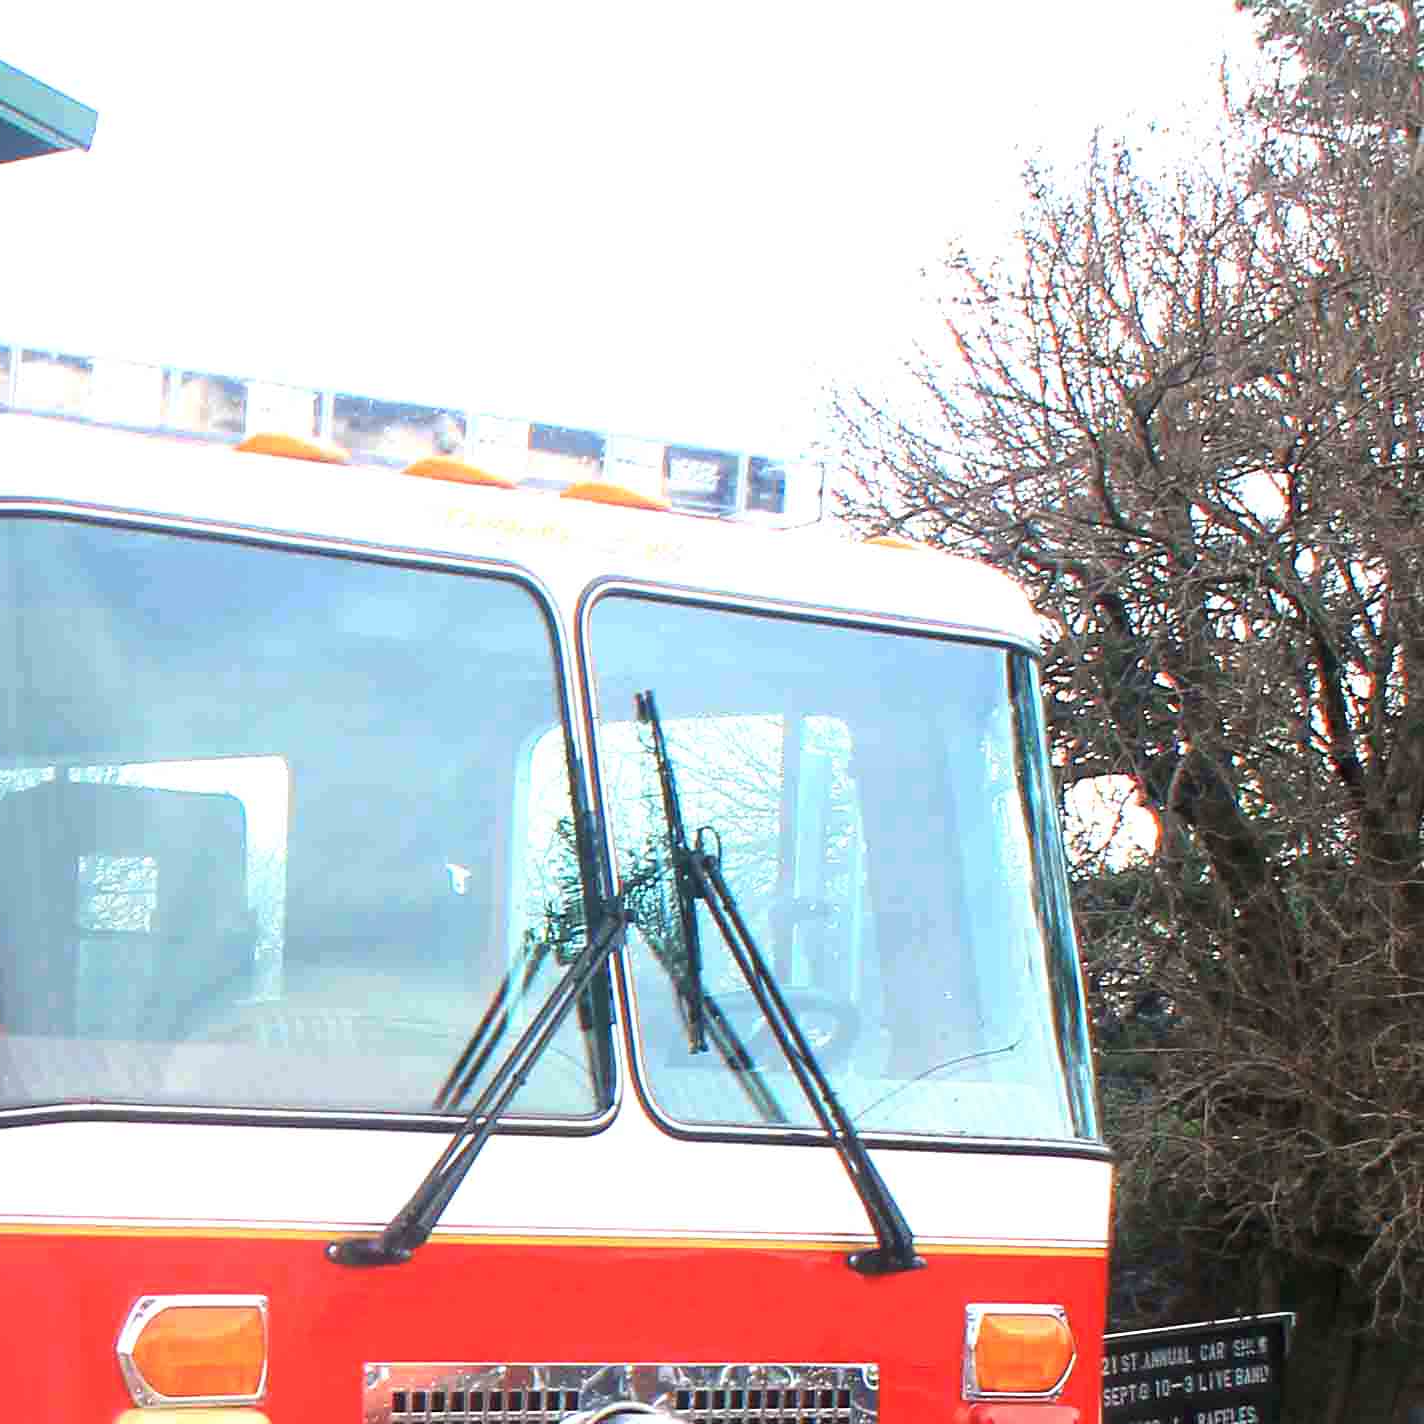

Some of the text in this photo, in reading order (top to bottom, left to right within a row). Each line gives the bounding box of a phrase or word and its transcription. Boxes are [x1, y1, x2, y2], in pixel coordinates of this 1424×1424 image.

[1199, 1341, 1225, 1361] CAR
[1103, 1383, 1137, 1408] SEPT
[1198, 1369, 1233, 1391] LIVE
